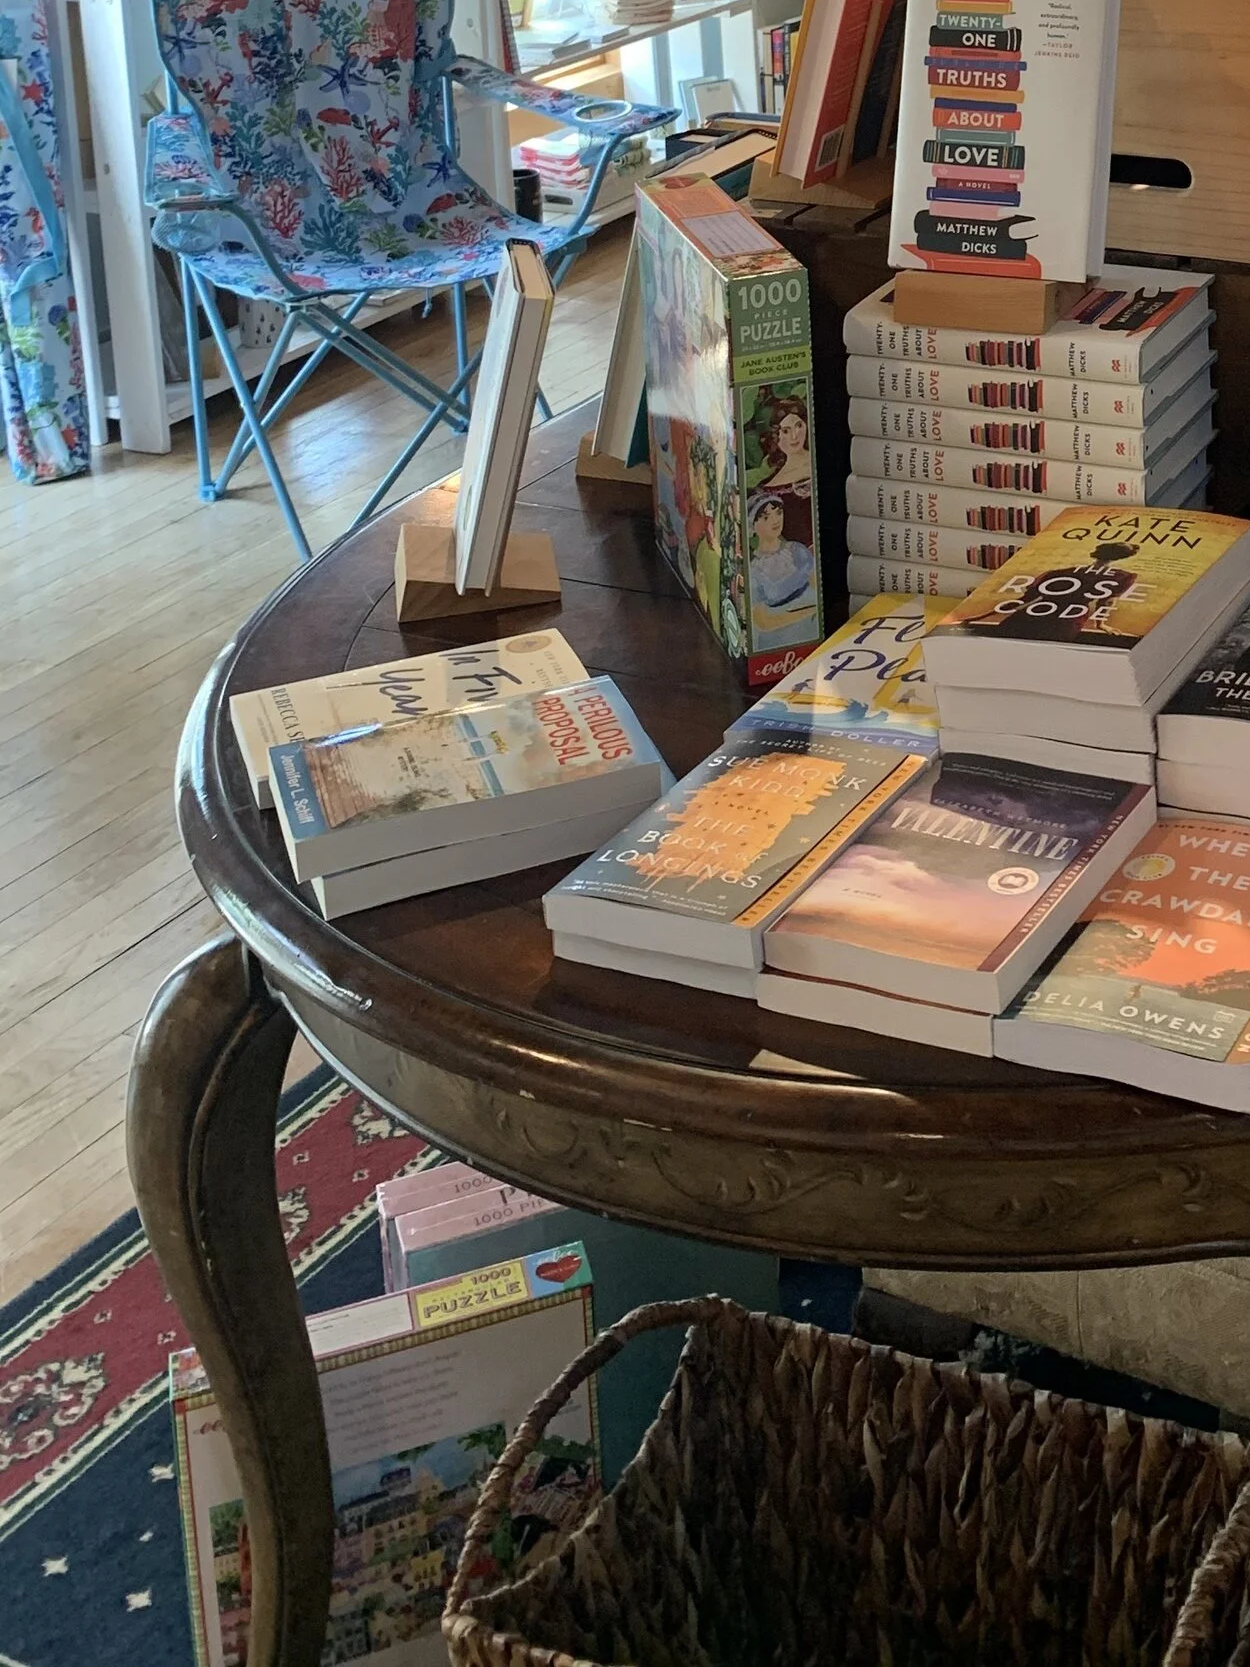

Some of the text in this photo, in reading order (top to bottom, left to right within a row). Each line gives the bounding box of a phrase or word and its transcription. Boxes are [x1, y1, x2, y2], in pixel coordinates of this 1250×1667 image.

[939, 13, 1001, 30] TWENTY-
[962, 32, 996, 48] ONE
[936, 68, 1007, 88] TRUTHS
[947, 111, 1005, 128] ABOUT
[943, 145, 999, 167] LOVE
[967, 182, 992, 190] NOVEL
[936, 221, 998, 237] MATTHEW
[961, 241, 997, 255] DICKS
[738, 278, 802, 311] 1000
[754, 309, 788, 319] PIECE
[740, 317, 802, 343] PUZZLE
[927, 327, 937, 359] LOVE
[741, 358, 763, 368] JANE
[749, 361, 799, 376] BOOK CLUB
[930, 370, 939, 402] LOVE
[907, 407, 915, 438] TRUTHS
[932, 410, 942, 441] LOVE
[1095, 515, 1196, 533] KATE
[1062, 528, 1202, 550] QUINN
[1072, 564, 1121, 576] THE
[998, 575, 1158, 602] ROSE
[994, 599, 1118, 621] CODE
[824, 649, 926, 682] Pla
[270, 687, 297, 729] REBECCA
[532, 696, 592, 766] PROPOSAL
[574, 694, 633, 762] PERILOUS
[752, 719, 815, 732] TRISH
[831, 730, 921, 747] DOLLER
[707, 755, 868, 791] SUE MONK
[280, 753, 299, 790] Jennifer
[293, 799, 315, 825] Schiff
[728, 775, 804, 799] KIDD
[694, 817, 752, 835] THE
[890, 807, 1079, 861] VALENTINE
[637, 830, 727, 854] BOOK
[596, 849, 762, 888] LONGINGS
[1125, 924, 1218, 955] SING
[1022, 990, 1226, 1040] DELIA OWENS
[454, 1175, 494, 1194] 1000
[475, 1207, 513, 1227] 1000
[471, 1267, 512, 1285] 1000
[423, 1280, 523, 1319] PUZZLE
